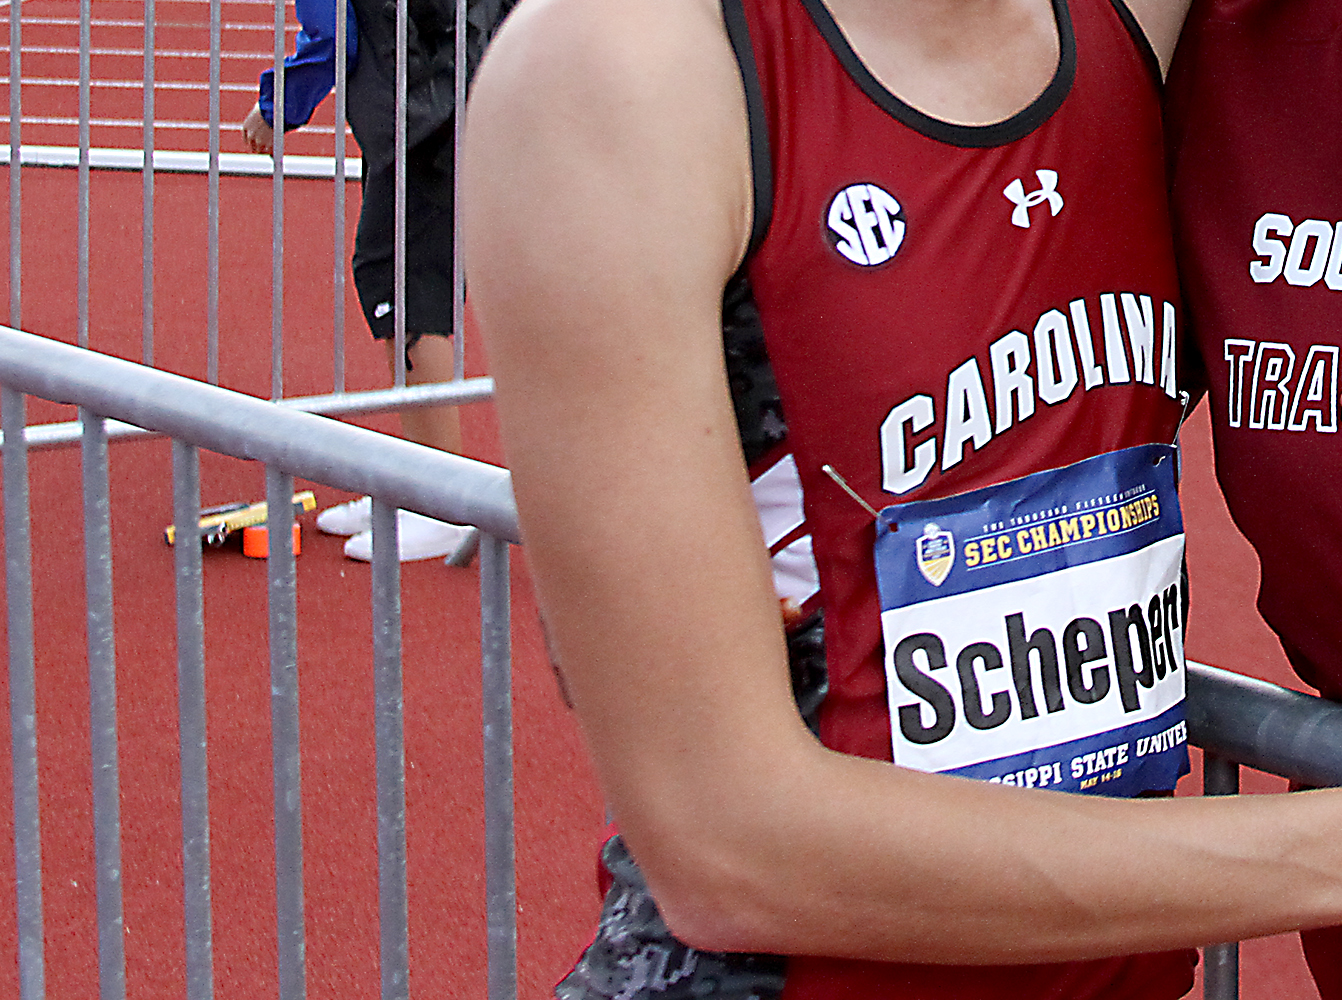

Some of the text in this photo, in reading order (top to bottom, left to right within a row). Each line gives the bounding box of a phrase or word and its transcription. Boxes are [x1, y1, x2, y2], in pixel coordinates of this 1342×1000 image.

[827, 183, 905, 266] SEC
[880, 292, 1177, 494] CAROLINA
[964, 535, 1013, 568] SEC
[1016, 494, 1161, 554] CHAMPIONSHIPS
[893, 583, 1180, 745] Scheper
[1070, 742, 1128, 778] STATE
